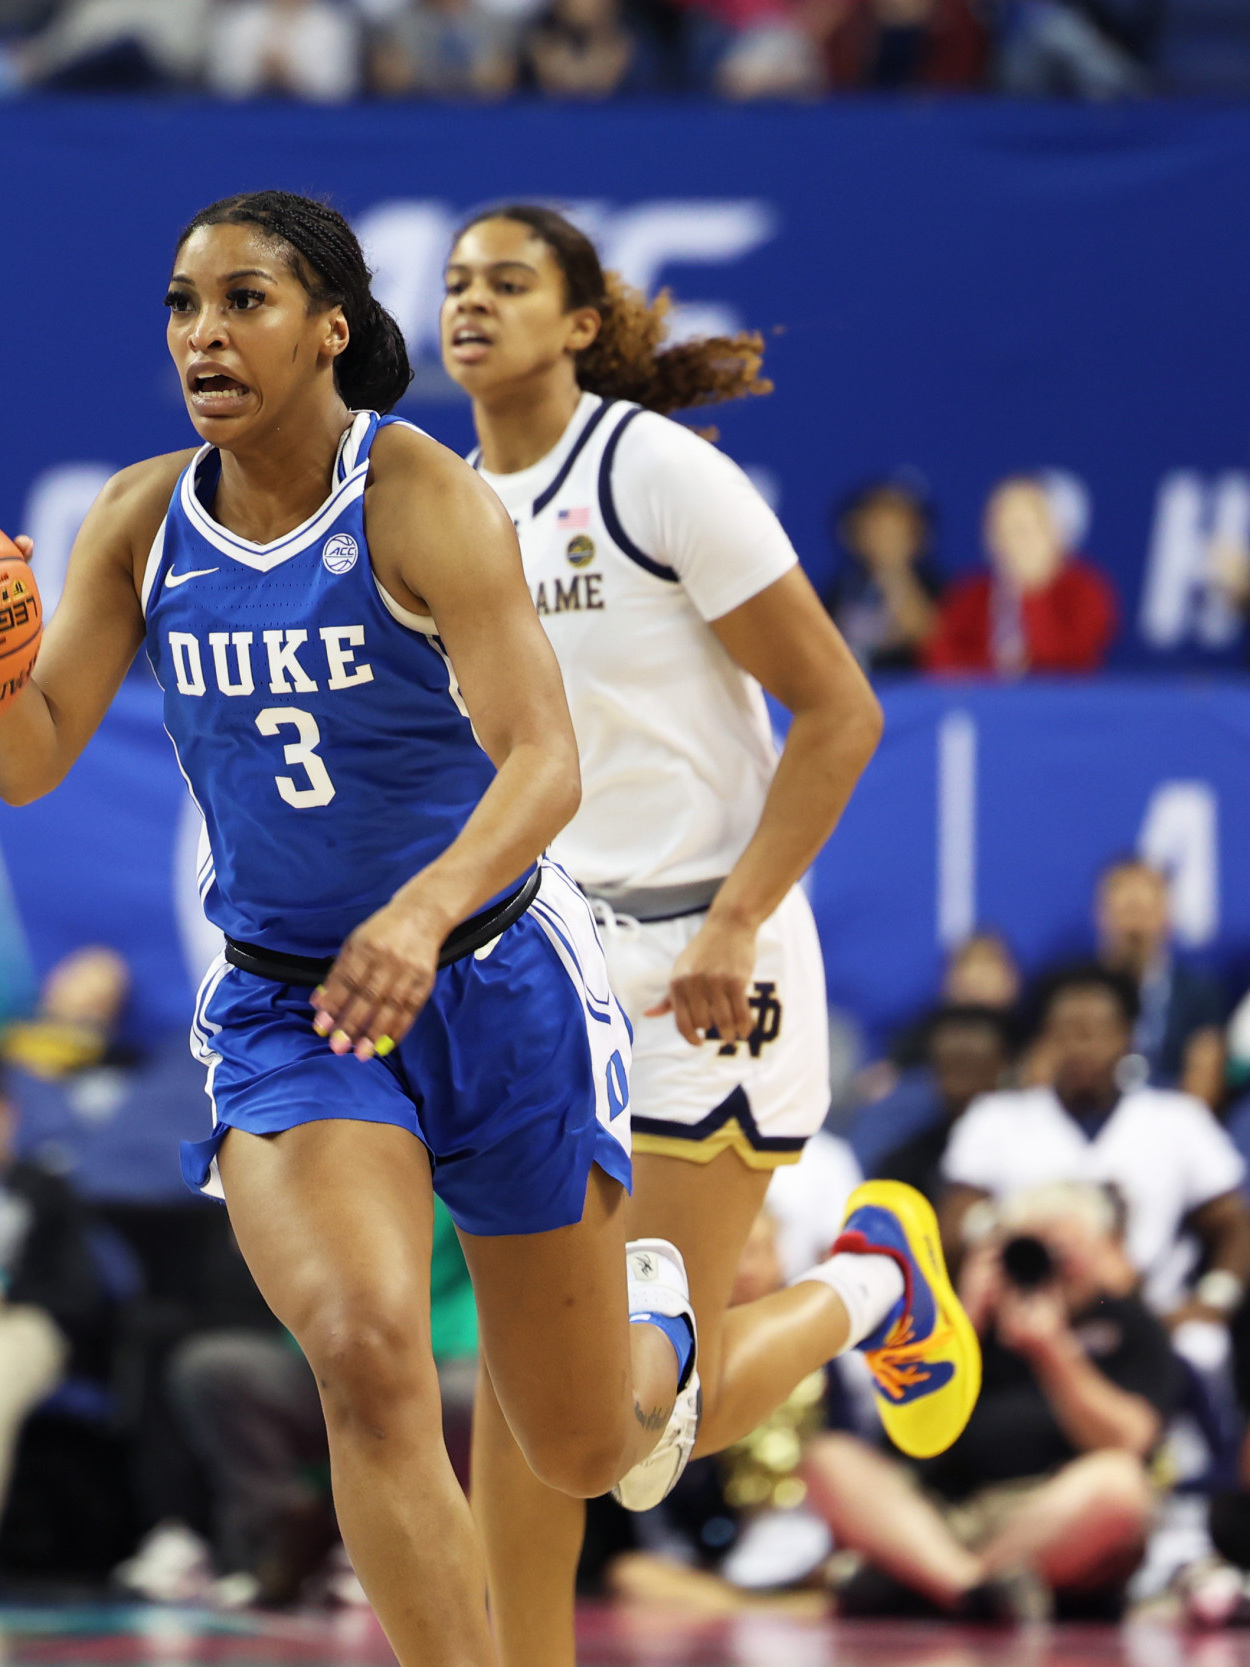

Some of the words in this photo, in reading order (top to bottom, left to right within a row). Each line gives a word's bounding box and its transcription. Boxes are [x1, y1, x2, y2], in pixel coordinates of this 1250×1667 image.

[329, 547, 355, 556] ACC
[536, 572, 605, 616] AME
[168, 624, 374, 697] DUKE
[254, 706, 336, 809] 3
